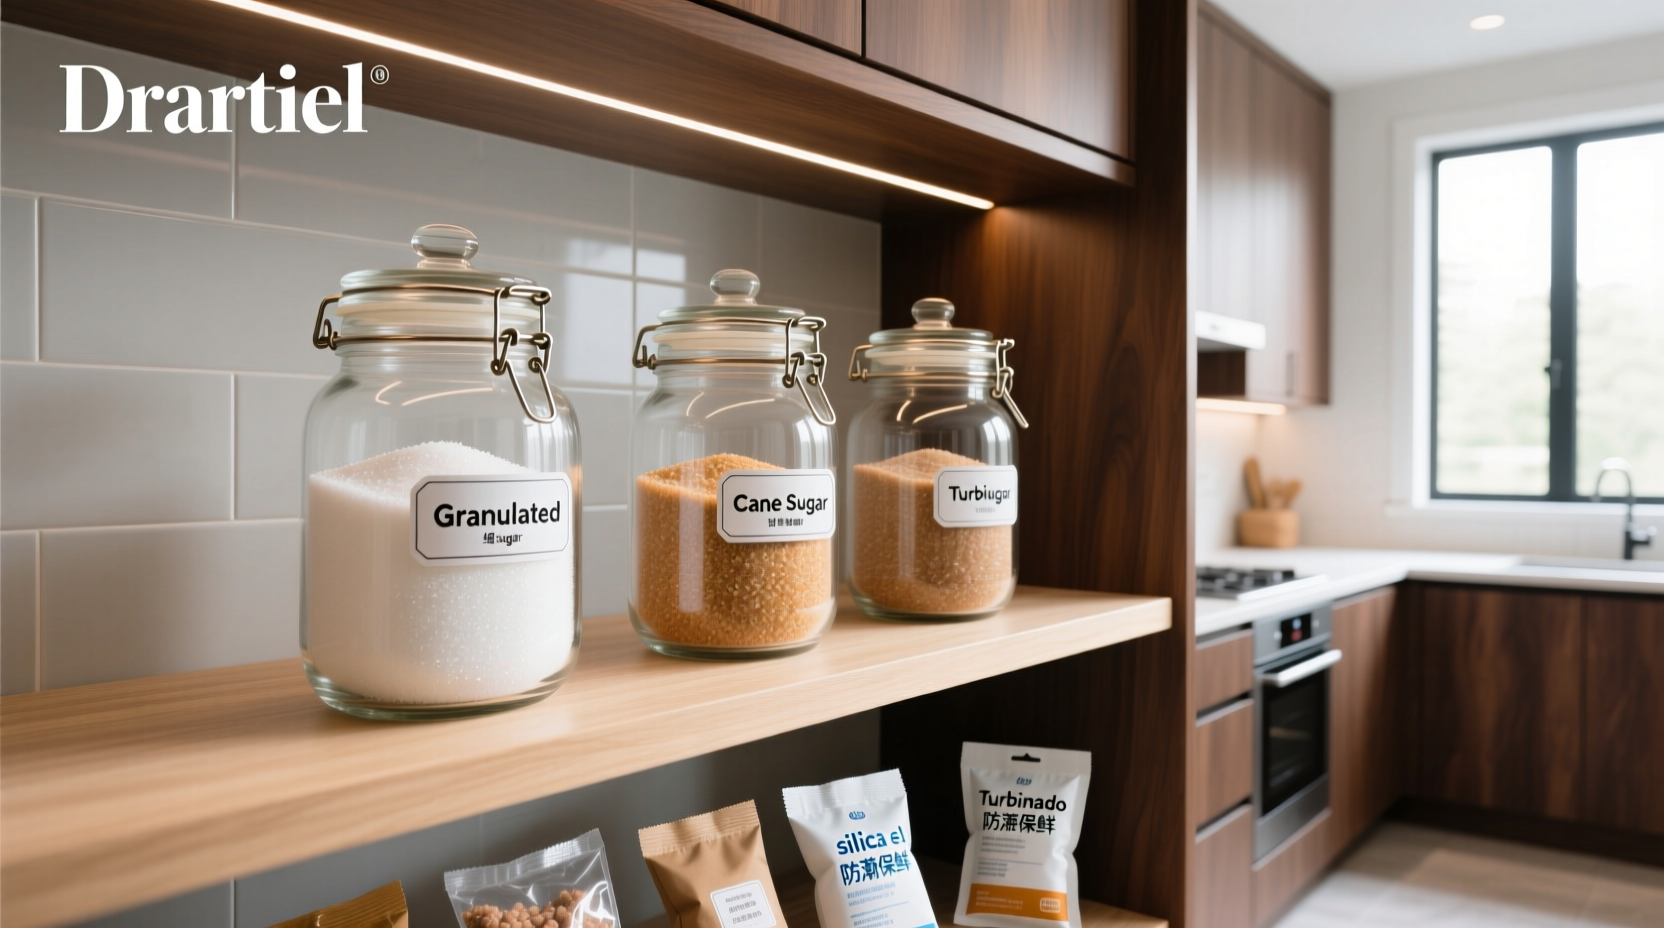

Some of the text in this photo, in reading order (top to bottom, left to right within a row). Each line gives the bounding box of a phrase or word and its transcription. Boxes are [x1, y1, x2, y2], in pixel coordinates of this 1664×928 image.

[433, 500, 561, 528] Granulated
[733, 493, 828, 515] Cane Sugar
[979, 790, 1067, 812] Turbinado
[836, 831, 888, 855] silica
